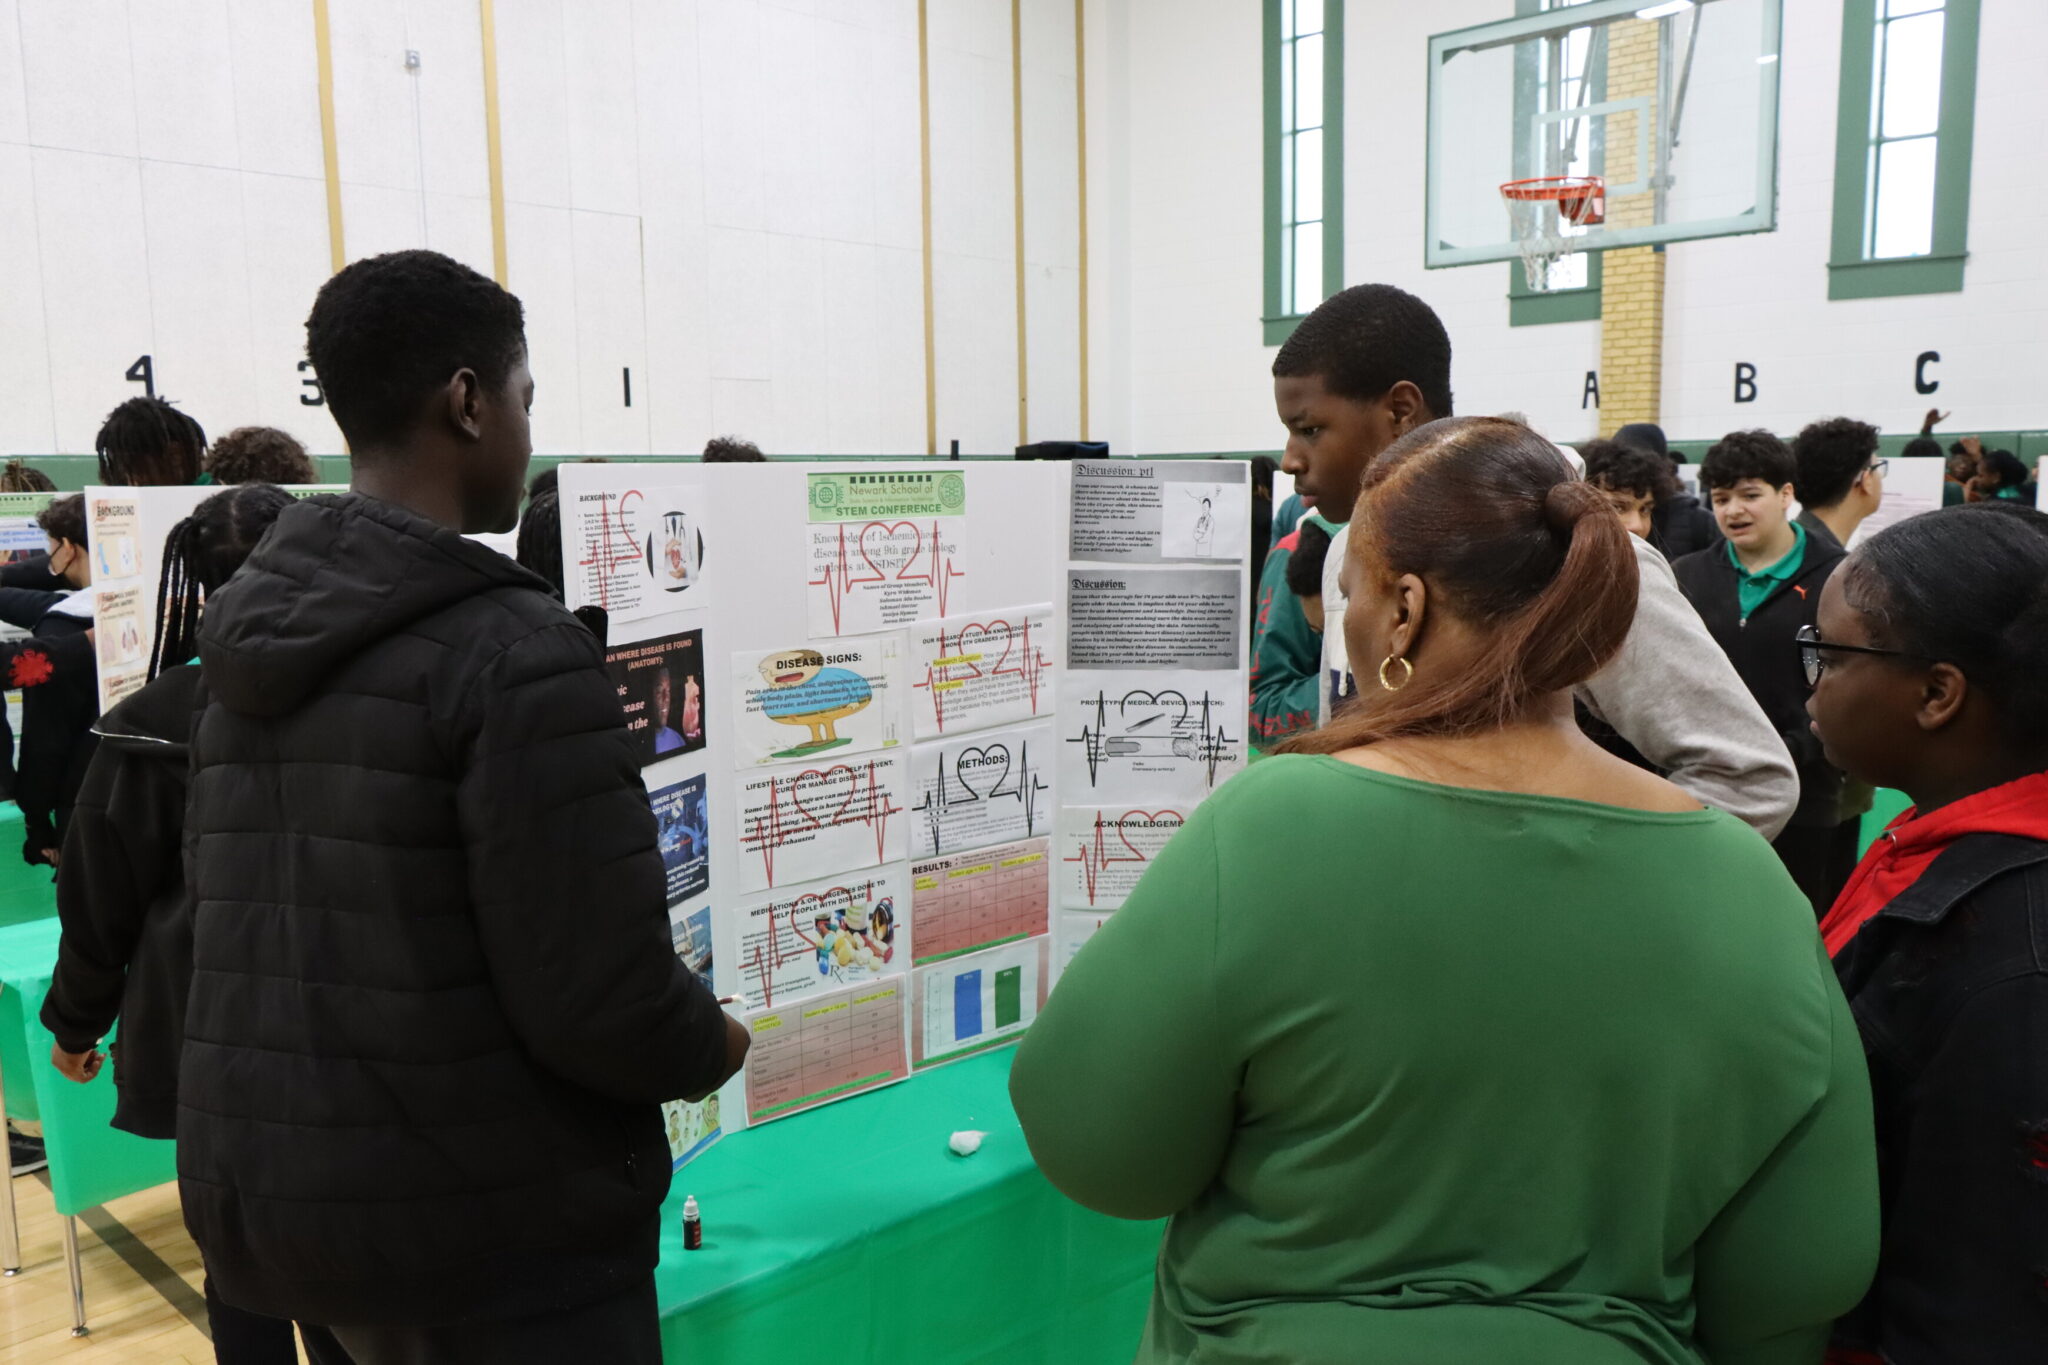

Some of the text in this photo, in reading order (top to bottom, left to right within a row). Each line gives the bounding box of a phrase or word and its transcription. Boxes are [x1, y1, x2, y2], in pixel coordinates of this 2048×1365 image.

[125, 355, 155, 397] 4
[1915, 351, 1940, 395] C
[298, 361, 324, 407] 3
[1582, 371, 1600, 409] A
[1734, 362, 1757, 403] B
[1075, 464, 1136, 476] Discussion:
[850, 483, 934, 495] Newark School of
[580, 494, 616, 502] BACKGROUND
[96, 505, 135, 517] BACKGROUND
[836, 504, 942, 516] STEM CONFERENCE
[866, 532, 876, 542] of
[920, 530, 942, 540] heart
[814, 542, 957, 560] disease among 9th grade biology
[814, 562, 855, 574] students
[856, 562, 866, 572] at
[1072, 578, 1126, 590] Discussion:
[936, 633, 964, 642] RESEARCH
[616, 648, 640, 660] WHERE
[640, 644, 665, 656] DISEASE
[666, 642, 672, 652] IS
[673, 638, 692, 650] FOUND
[628, 656, 664, 672] (ANATOMY):
[776, 653, 862, 670] DISEASE SIGNS:
[623, 700, 646, 713] ease
[634, 717, 649, 730] the
[958, 754, 1008, 770] METHODS:
[746, 760, 894, 791] LIFESTYLE CHANGES WHICH HELP PREVENT,
[670, 788, 691, 800] DISEASE
[776, 785, 795, 794] CURE
[808, 778, 837, 788] MANAGE
[744, 806, 763, 814] Some
[764, 801, 790, 810] lifestyle
[791, 797, 814, 806] change
[836, 790, 854, 798] make
[862, 784, 886, 794] prevent
[794, 806, 818, 814] disease
[852, 793, 880, 804] balanced
[833, 808, 859, 817] diabetes
[782, 834, 816, 846] exhausted
[912, 860, 952, 875] RESULTS:
[751, 901, 798, 917] MEDICATIONS
[822, 886, 856, 900] SURGERIES
[772, 910, 790, 920] HELP
[791, 904, 819, 916] PEOPLE
[820, 900, 837, 910] WITH
